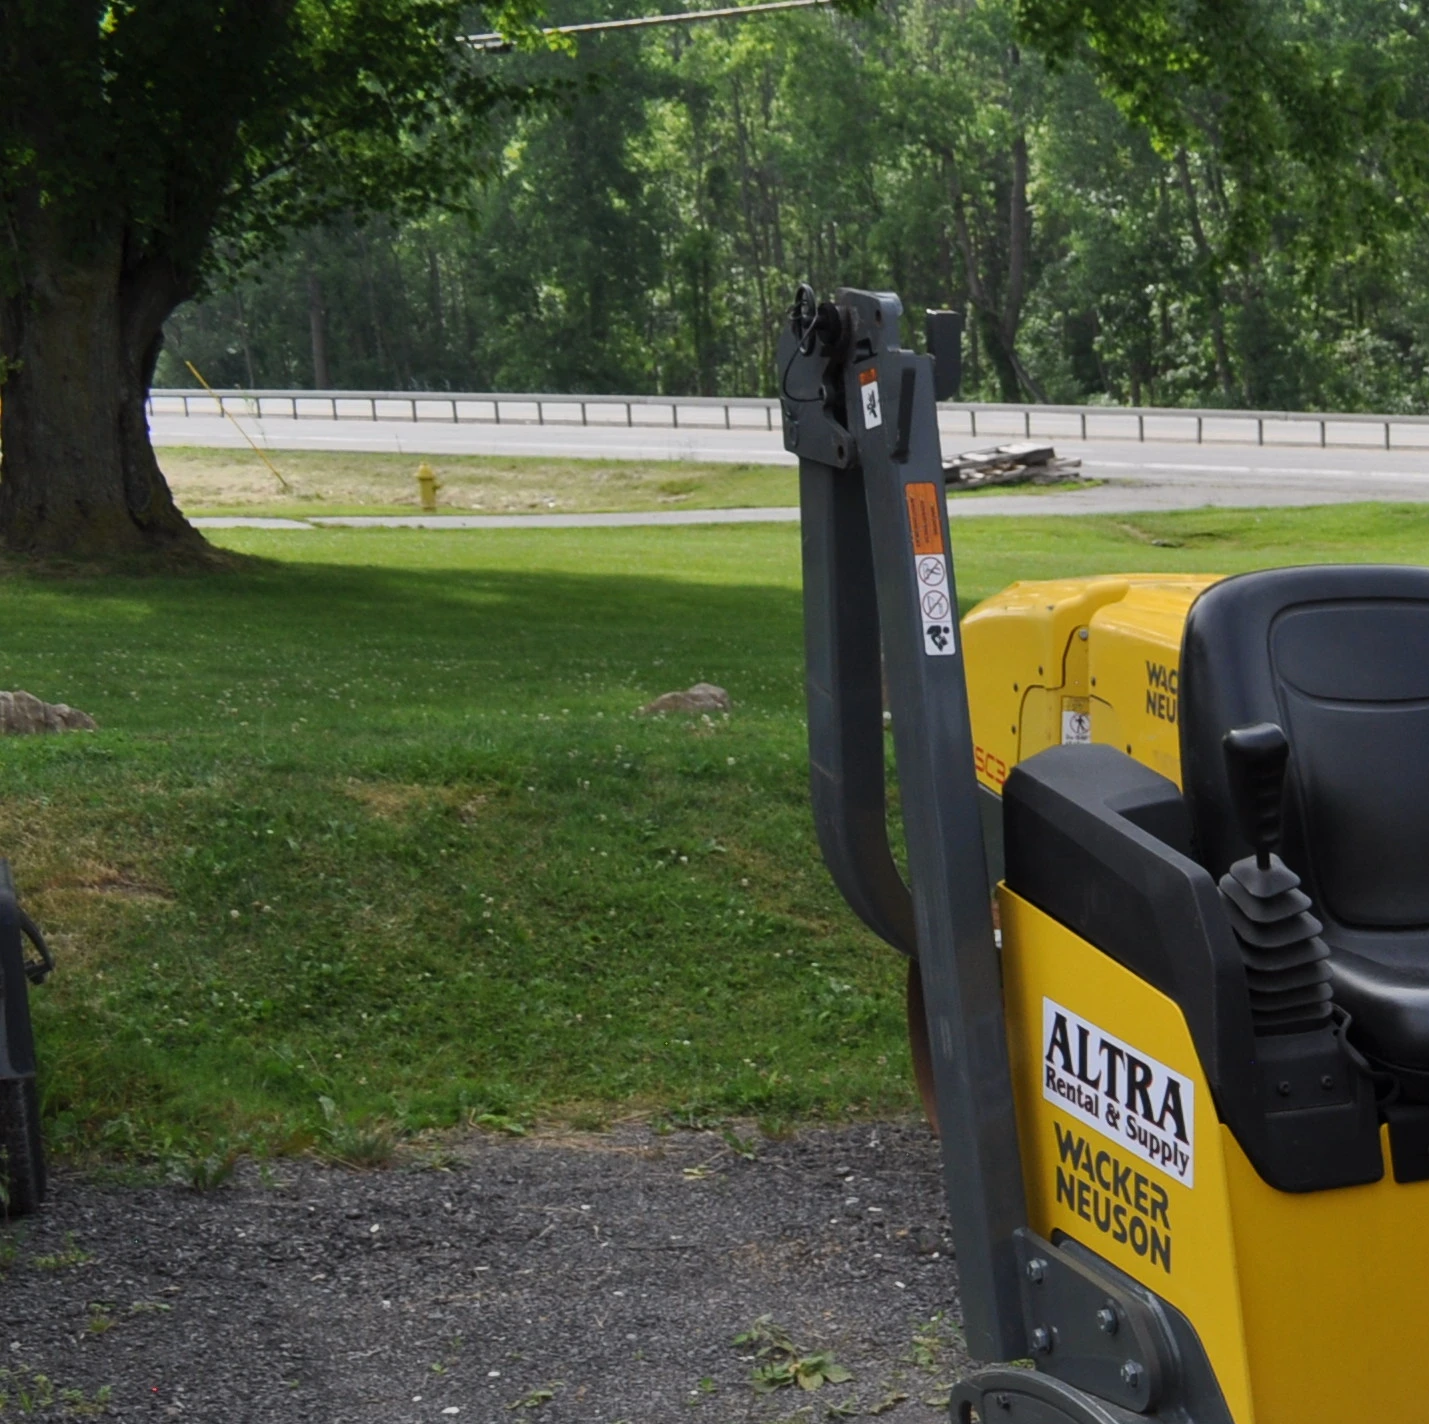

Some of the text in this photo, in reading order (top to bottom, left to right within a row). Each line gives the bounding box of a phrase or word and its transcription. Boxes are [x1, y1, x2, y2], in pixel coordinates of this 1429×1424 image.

[1146, 659, 1178, 696] WAC
[1146, 688, 1176, 724] NEU
[1045, 1011, 1190, 1146] ALTRA
[1045, 1064, 1190, 1178] Rental & Supply
[1054, 1120, 1171, 1231] WACKER
[1056, 1166, 1171, 1274] NEUSON
